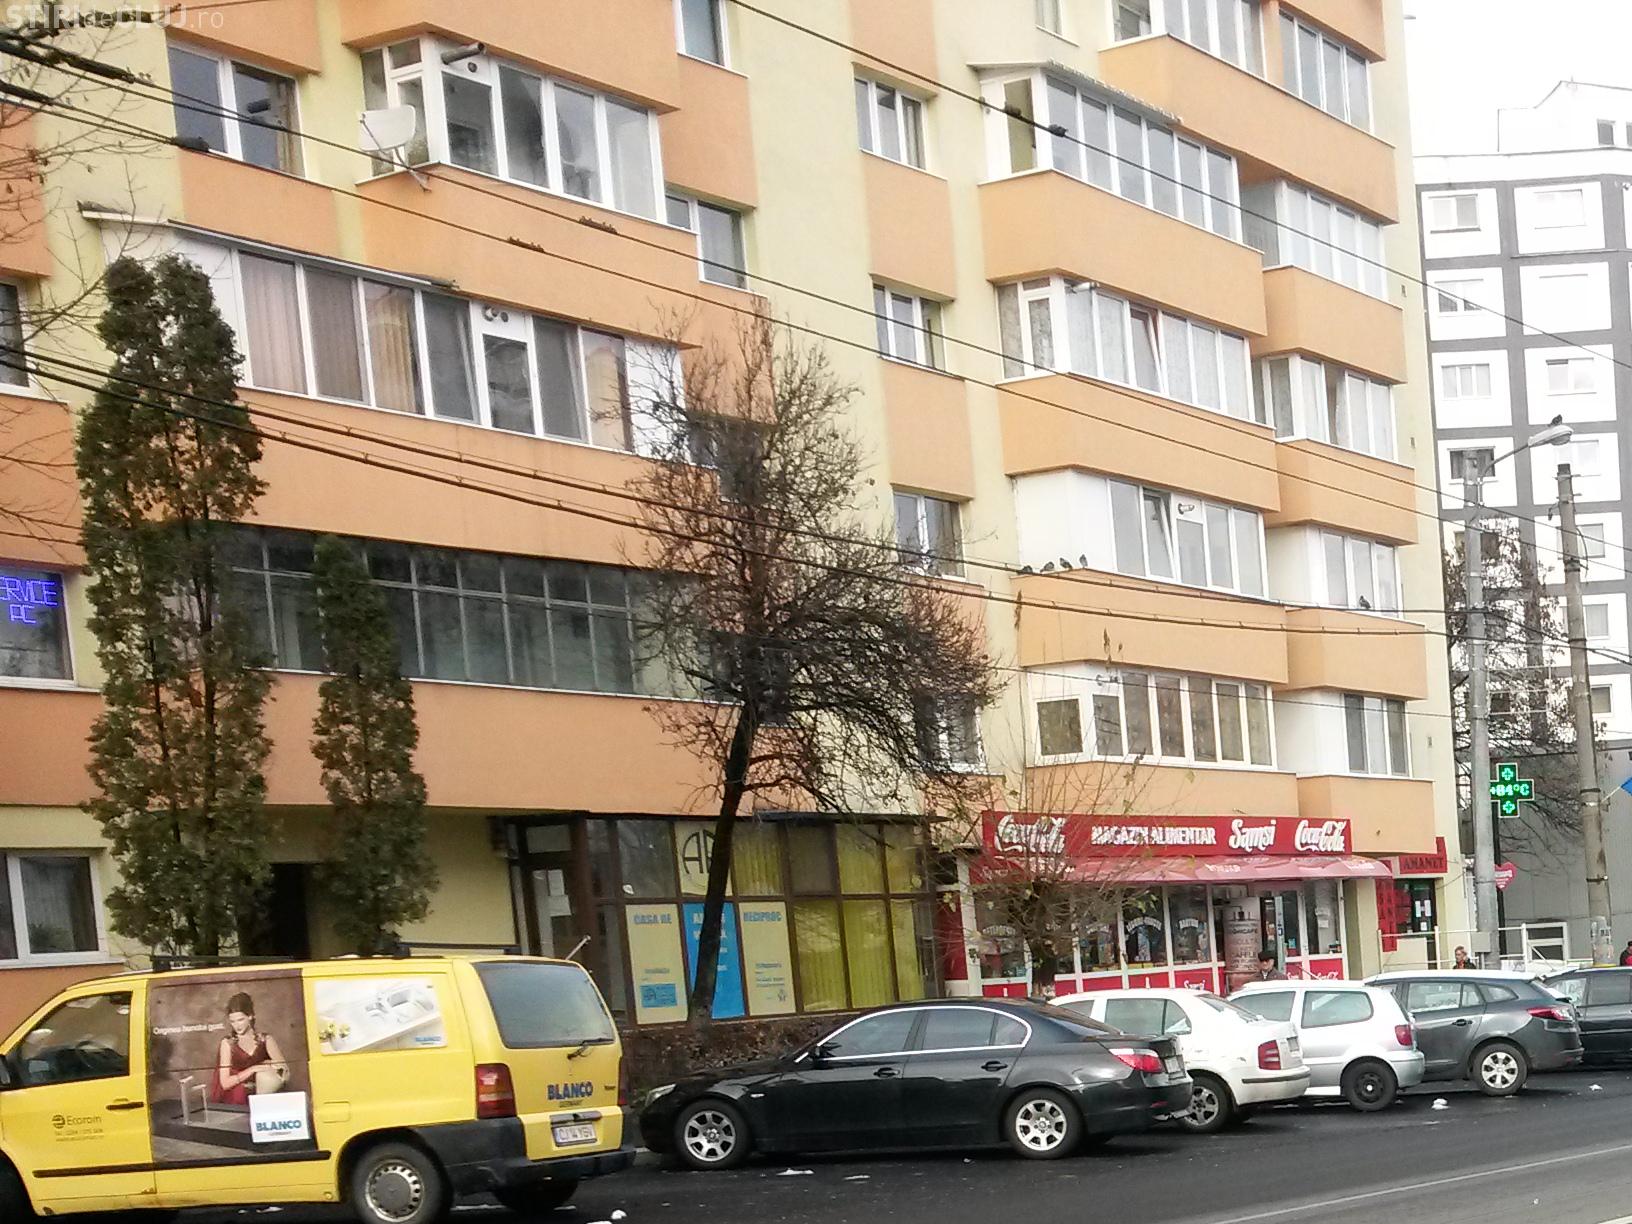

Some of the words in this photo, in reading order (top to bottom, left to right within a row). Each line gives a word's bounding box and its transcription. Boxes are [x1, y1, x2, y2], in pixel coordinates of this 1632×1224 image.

[10, 603, 36, 624] PC
[1152, 826, 1217, 845] ALIMENTAR
[1229, 818, 1277, 852] Samsi
[1295, 819, 1347, 852] Coca-Cola
[547, 1081, 594, 1101] BLANCO
[256, 1120, 301, 1132] BLANCO
